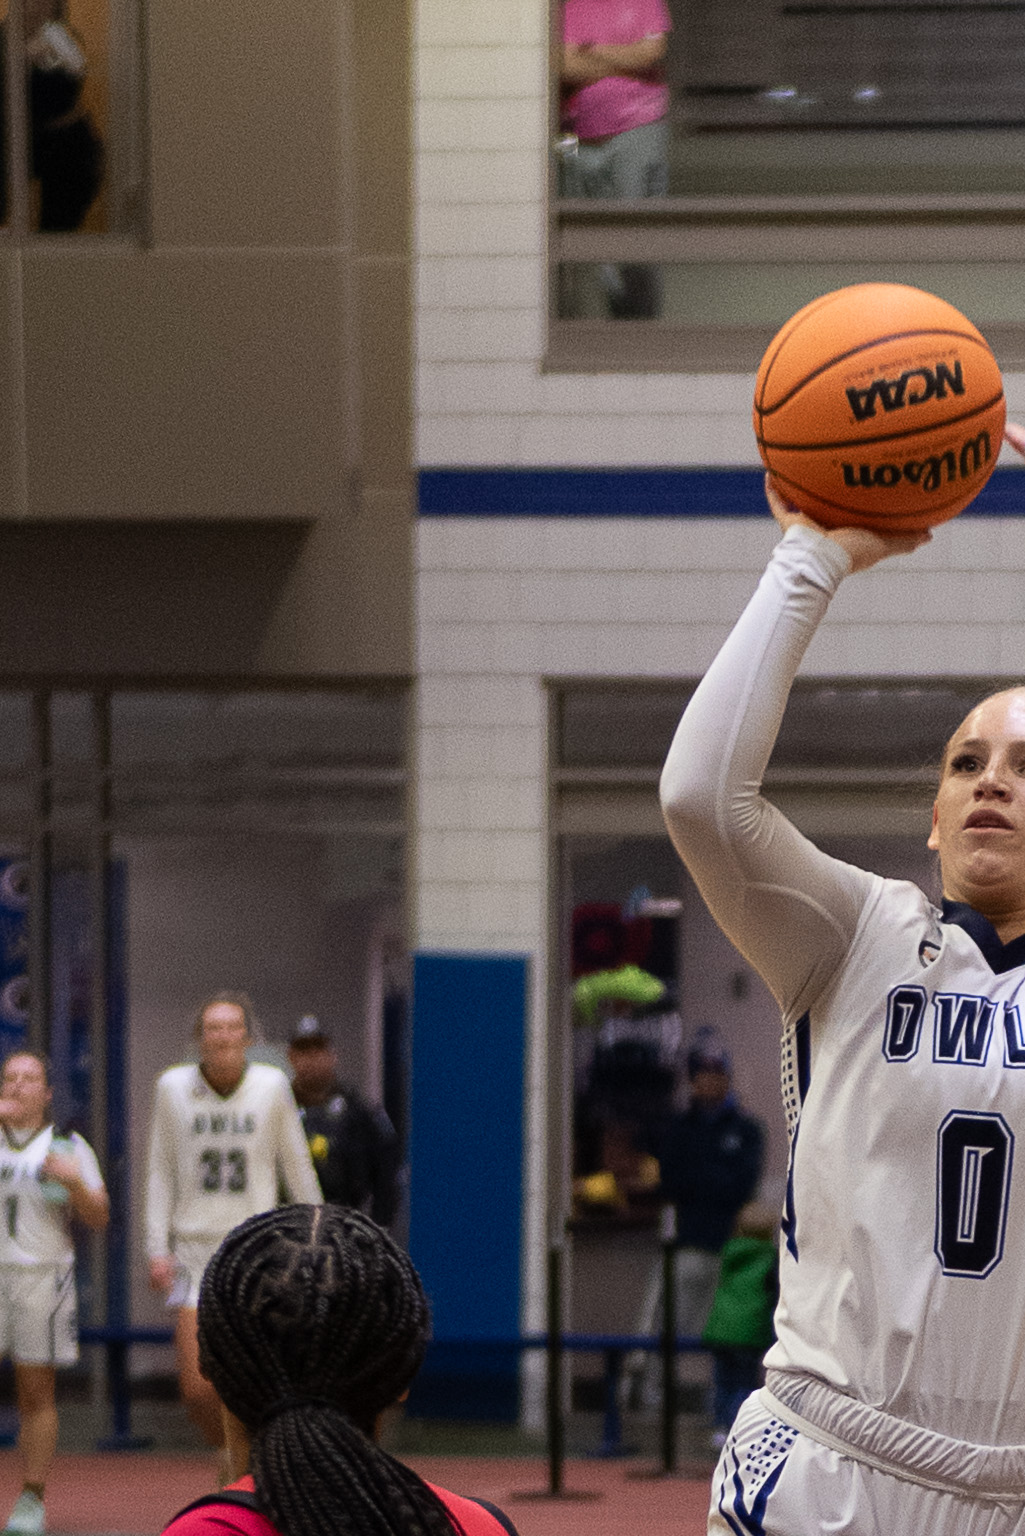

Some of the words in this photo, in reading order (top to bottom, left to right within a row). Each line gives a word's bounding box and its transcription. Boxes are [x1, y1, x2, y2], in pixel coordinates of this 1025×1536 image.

[845, 360, 966, 422] NCAA
[842, 431, 991, 492] Wilson
[933, 1109, 1015, 1279] 0
